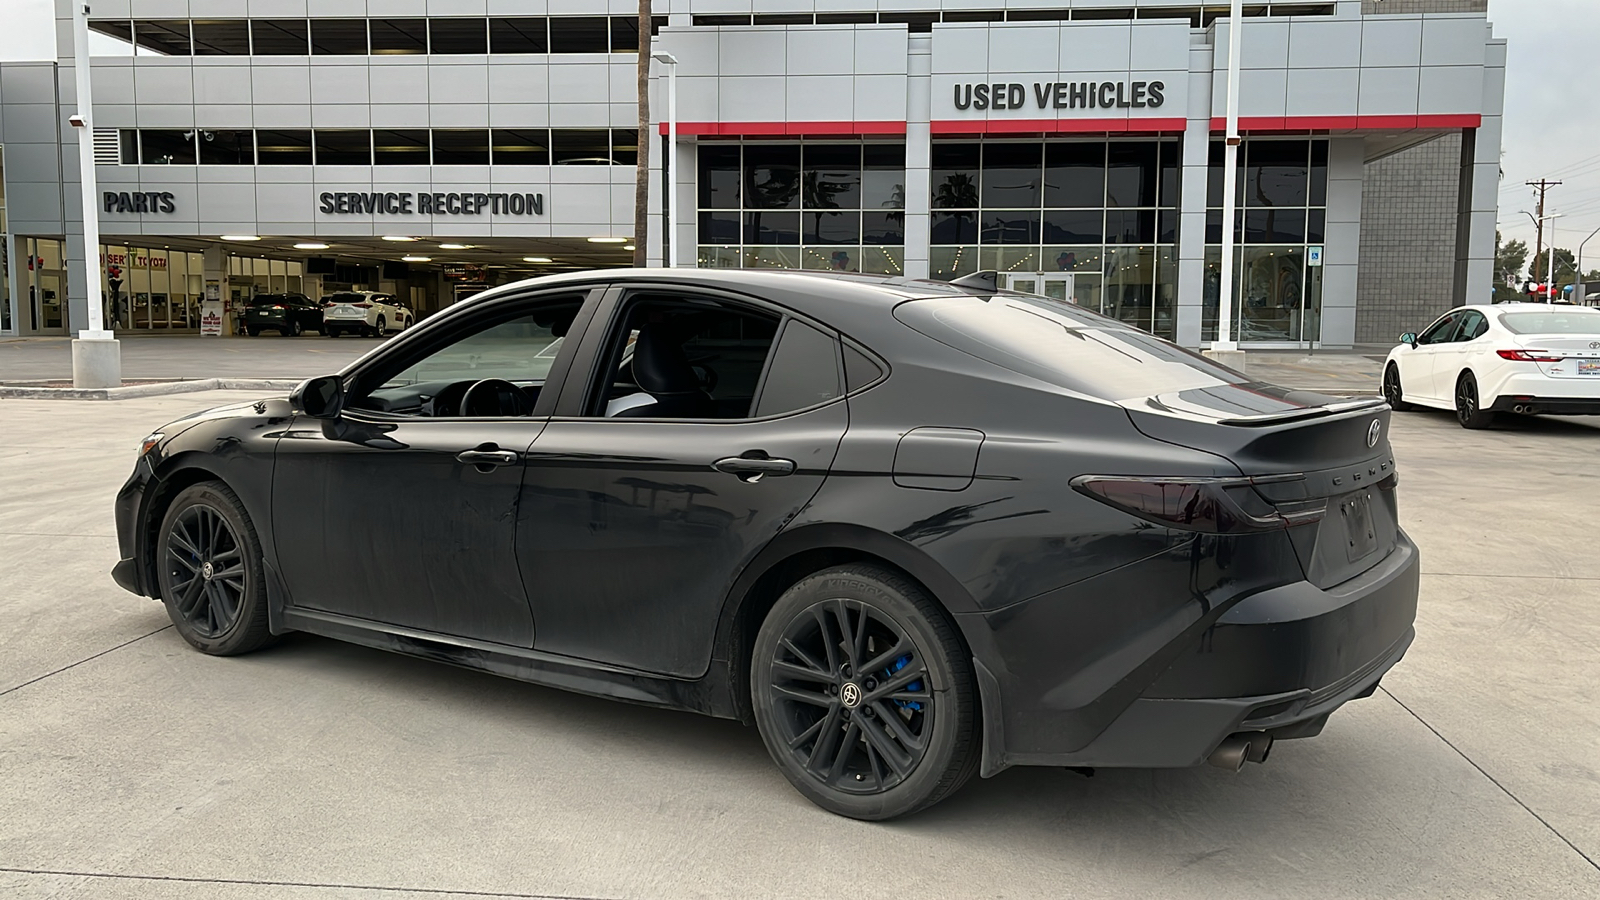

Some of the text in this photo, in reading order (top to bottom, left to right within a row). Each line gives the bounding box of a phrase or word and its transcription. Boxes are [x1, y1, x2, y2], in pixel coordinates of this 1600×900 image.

[954, 81, 1165, 110] USED VEHICLES
[103, 191, 175, 213] PARTS
[319, 192, 544, 215] SERVICE RECEPTION
